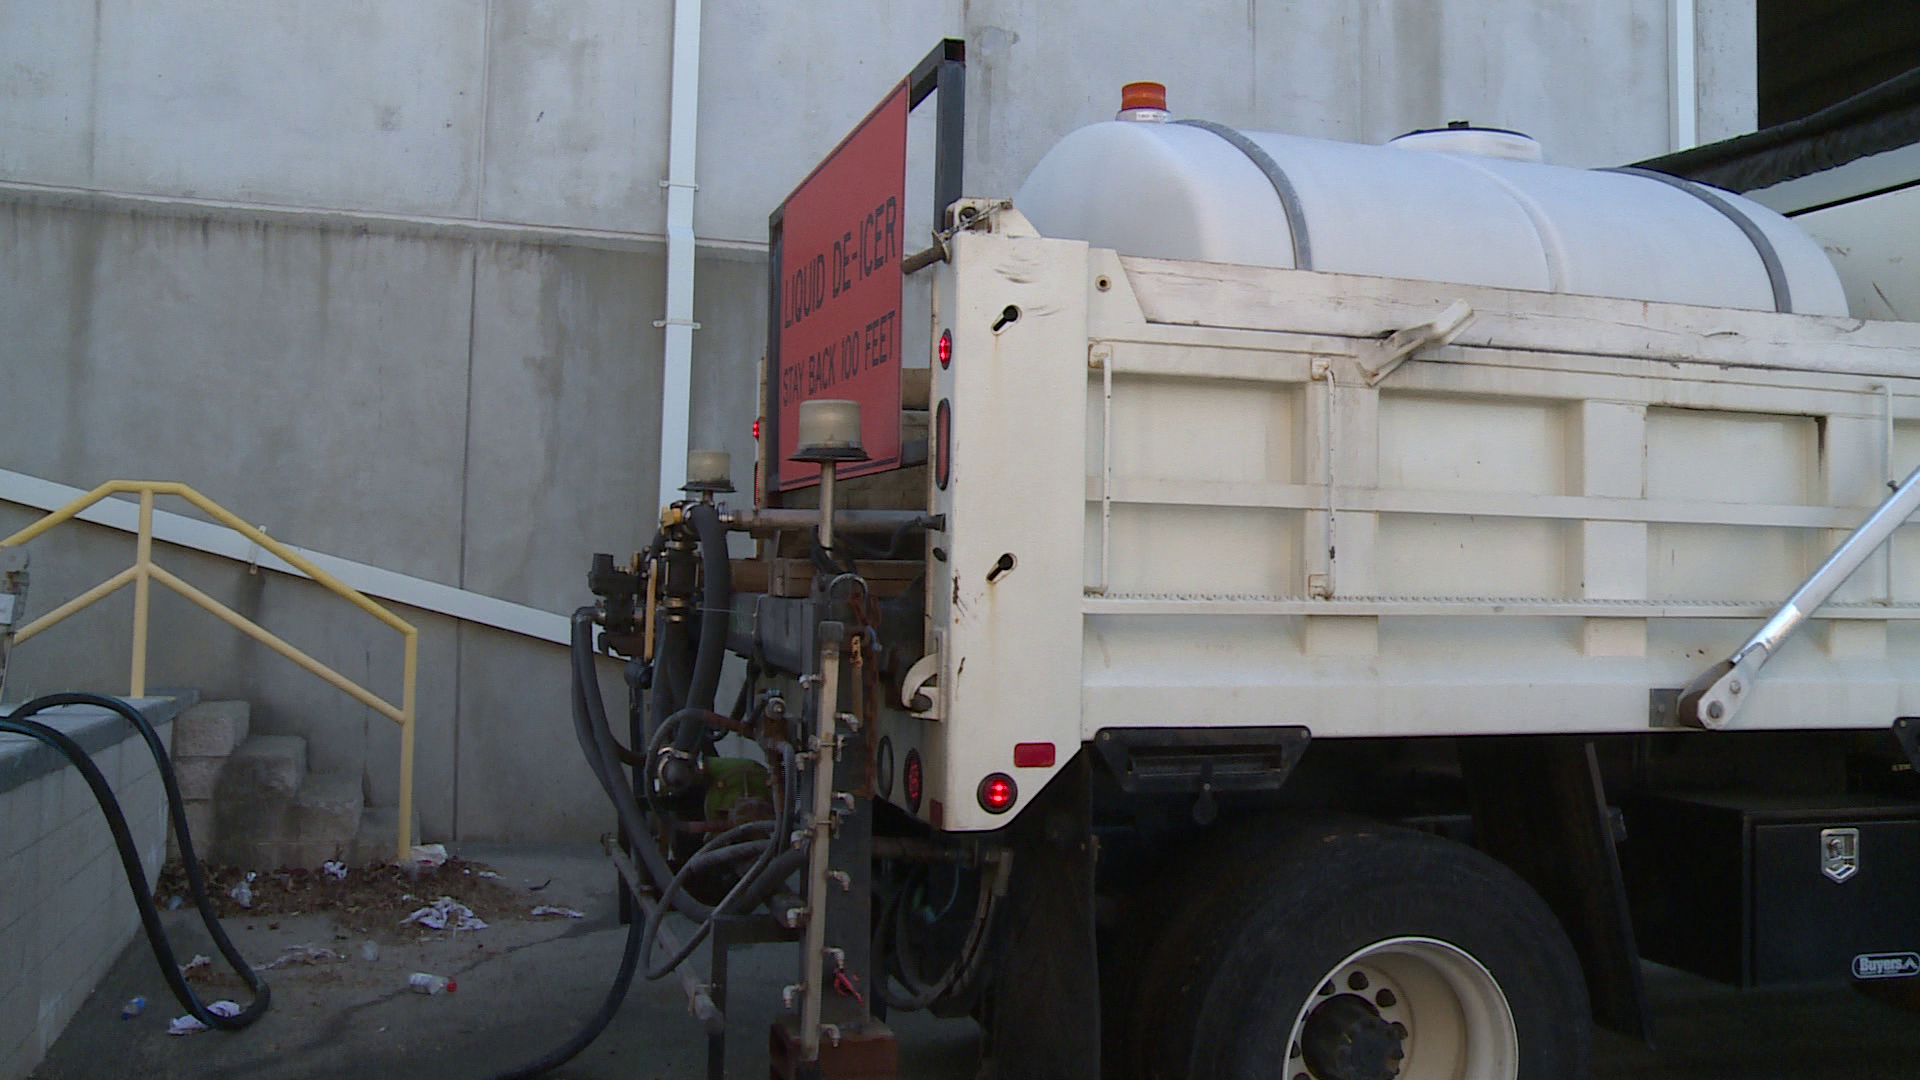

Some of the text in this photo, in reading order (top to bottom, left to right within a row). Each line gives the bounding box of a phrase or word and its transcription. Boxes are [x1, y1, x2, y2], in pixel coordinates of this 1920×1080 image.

[784, 195, 896, 328] LIQUID DE-ICER
[783, 310, 896, 407] STAY BACK 100 FEET
[1859, 957, 1903, 974] Buyers
